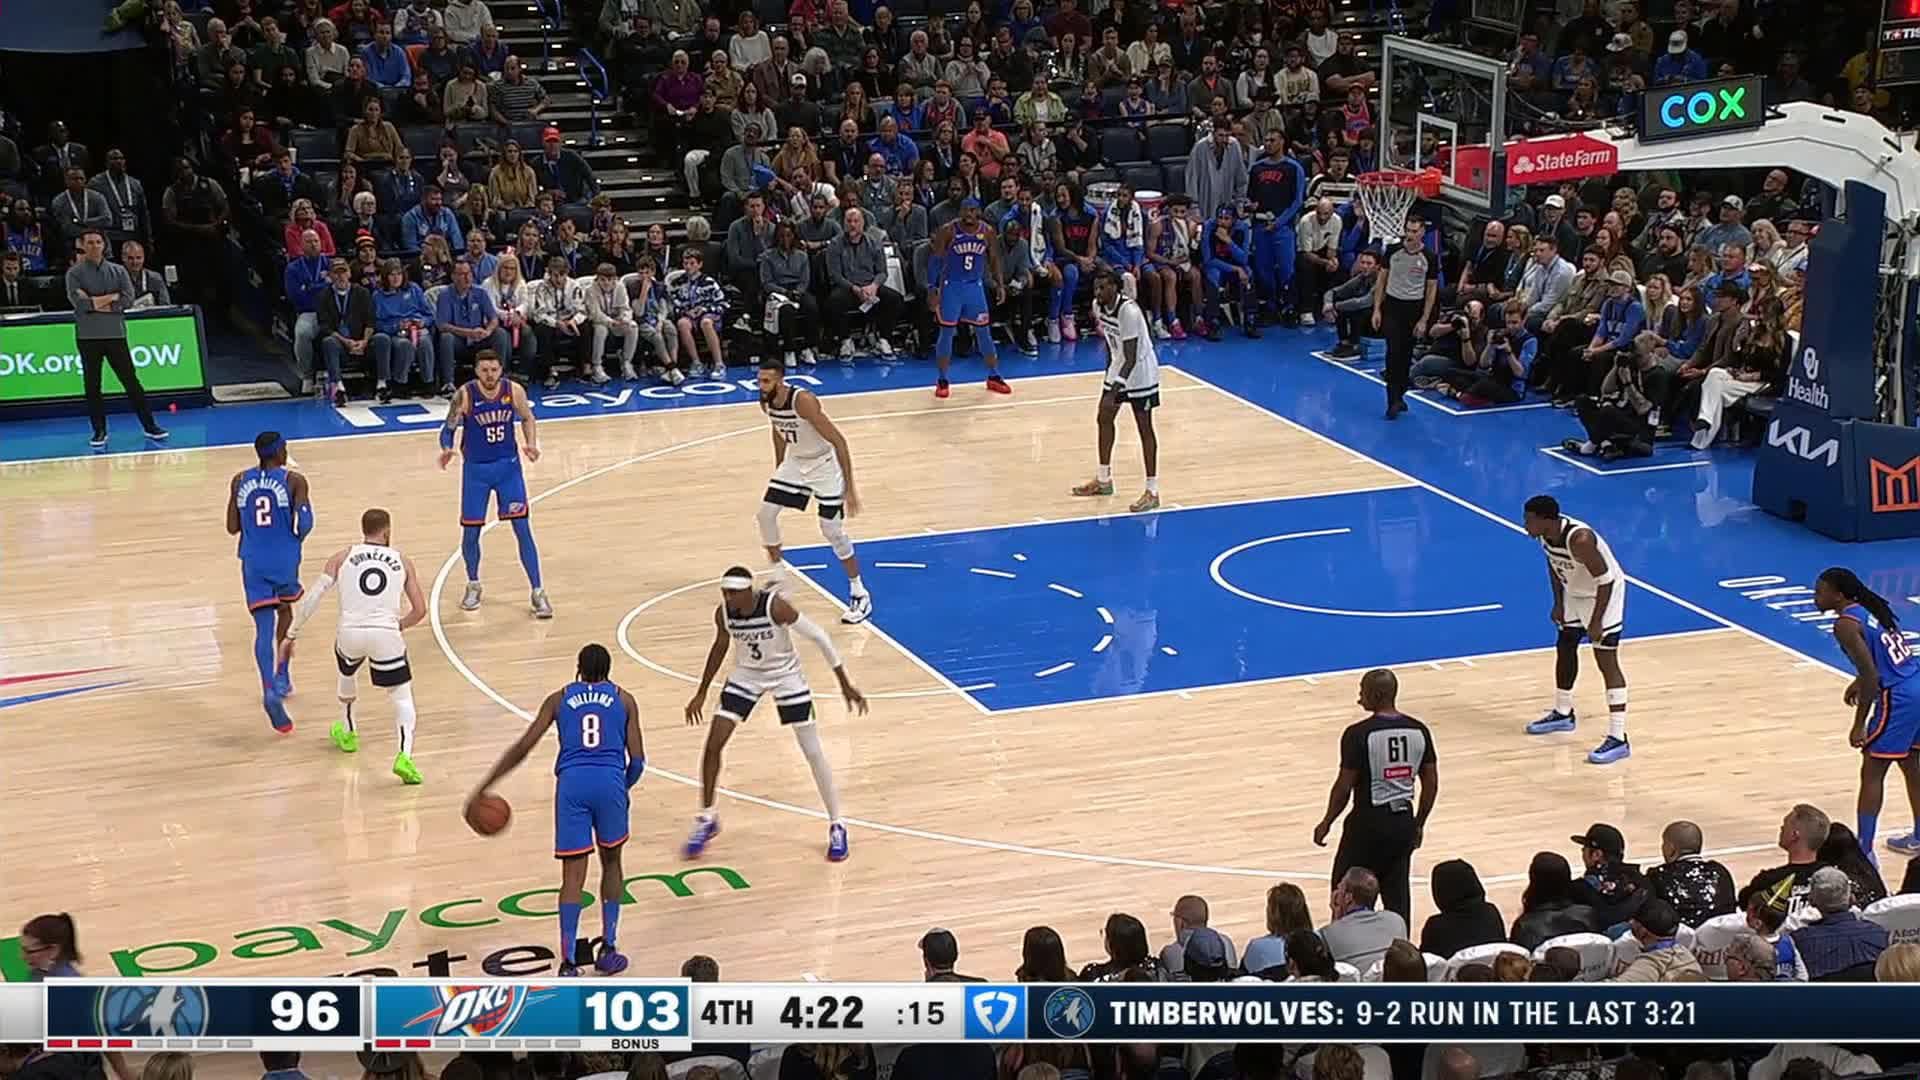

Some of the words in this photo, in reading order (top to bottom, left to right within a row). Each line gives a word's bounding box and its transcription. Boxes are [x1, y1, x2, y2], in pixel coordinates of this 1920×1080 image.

[1660, 87, 1745, 128] COX
[964, 255, 974, 270] 5
[130, 343, 181, 367] OW
[528, 374, 823, 408] aycom
[1788, 376, 1830, 409] Health
[475, 409, 512, 427] THUNDER
[486, 426, 505, 443] 55
[255, 496, 271, 527] 2
[747, 642, 763, 660] 3
[566, 692, 615, 710] WILLIAMS
[582, 713, 600, 748] 8
[1388, 735, 1408, 762] 61
[109, 866, 751, 977] paycom
